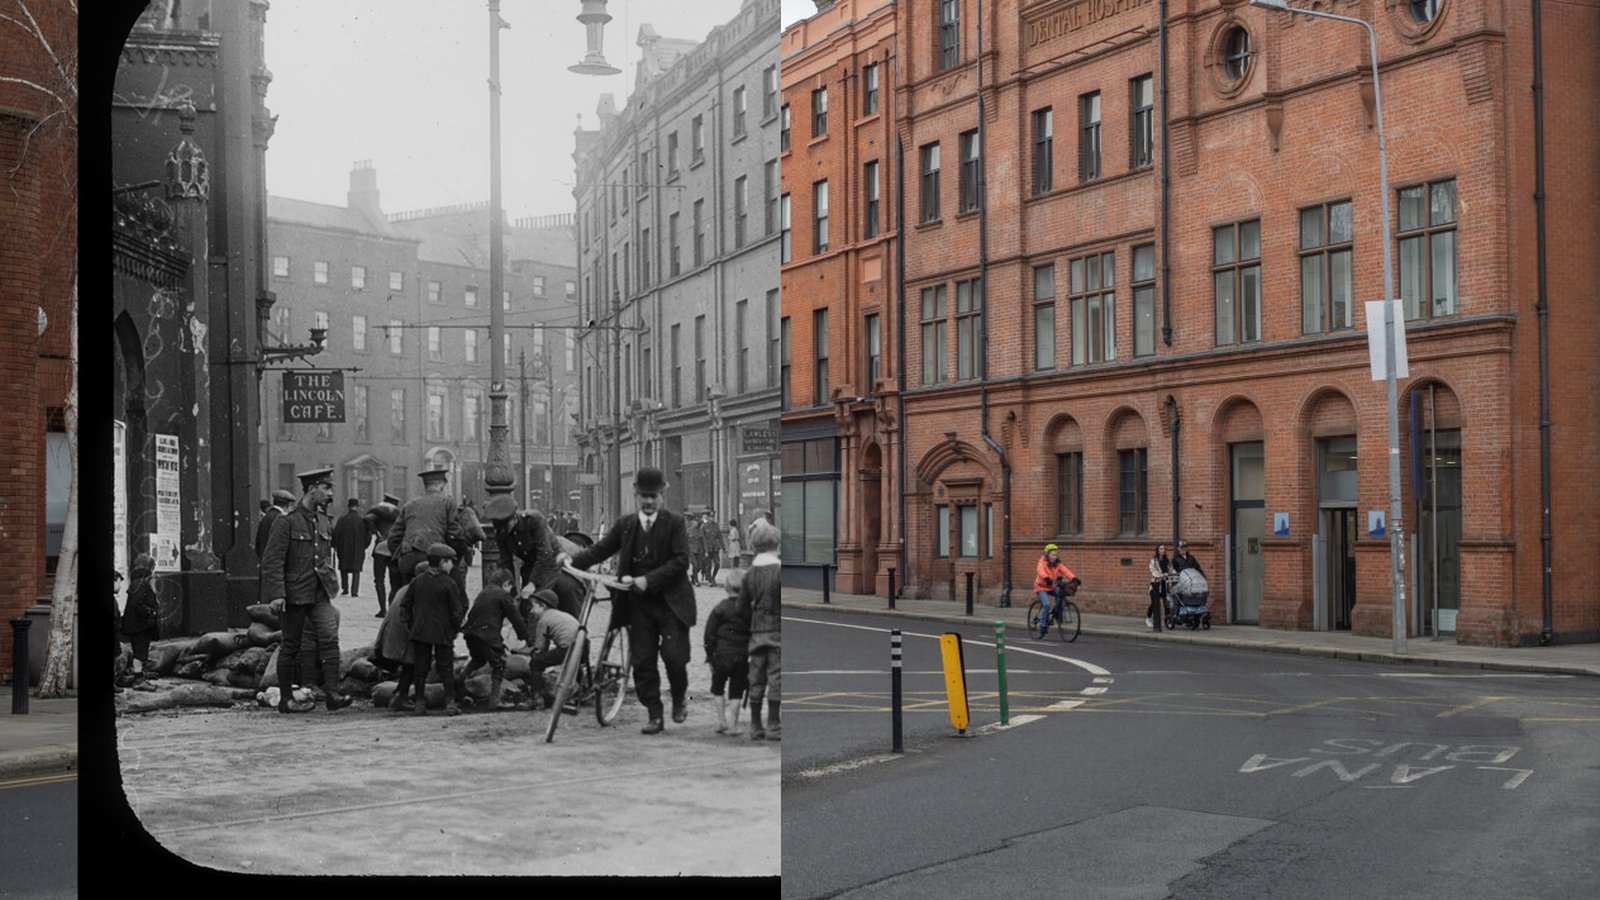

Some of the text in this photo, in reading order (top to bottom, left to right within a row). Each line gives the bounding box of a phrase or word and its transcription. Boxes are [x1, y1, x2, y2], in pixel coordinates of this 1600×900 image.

[1030, 0, 1153, 47] DENTAL HOSP
[294, 375, 331, 387] THE
[284, 389, 344, 401] LINCOLN
[1310, 738, 1521, 763] BUS
